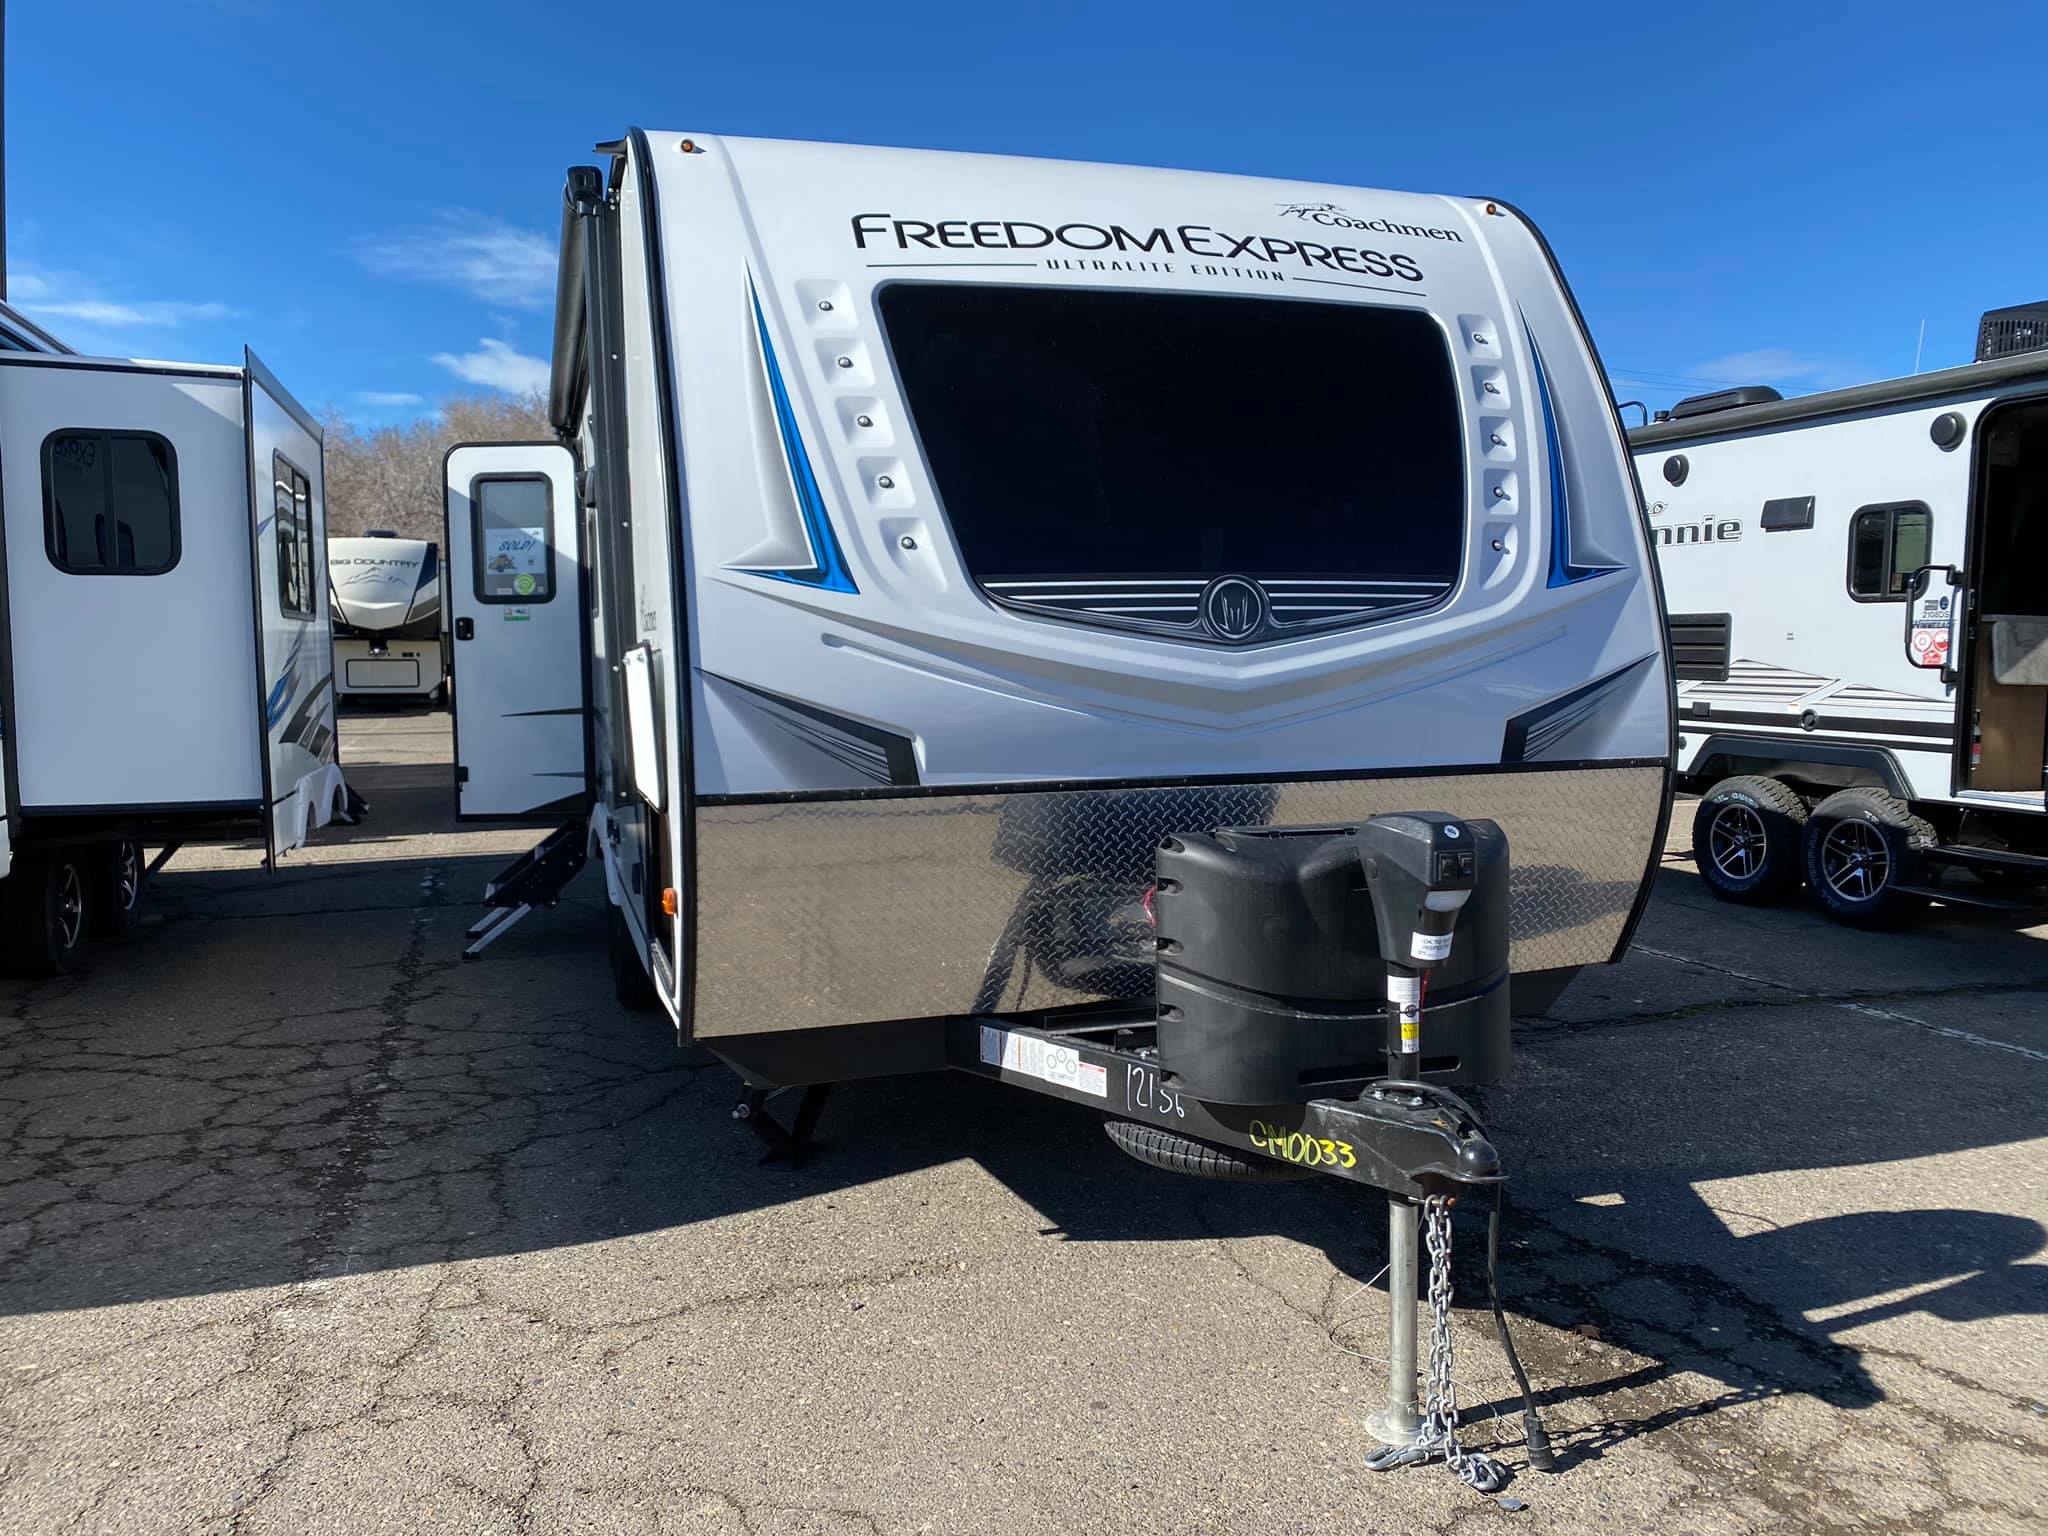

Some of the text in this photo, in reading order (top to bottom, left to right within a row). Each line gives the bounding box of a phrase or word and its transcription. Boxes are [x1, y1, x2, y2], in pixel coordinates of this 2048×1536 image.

[1311, 211, 1465, 243] Coachmen
[1046, 259, 1285, 282] ULTRALITE EDITION
[1652, 513, 1743, 547] nnie
[330, 558, 420, 568] BIG COUNTRY
